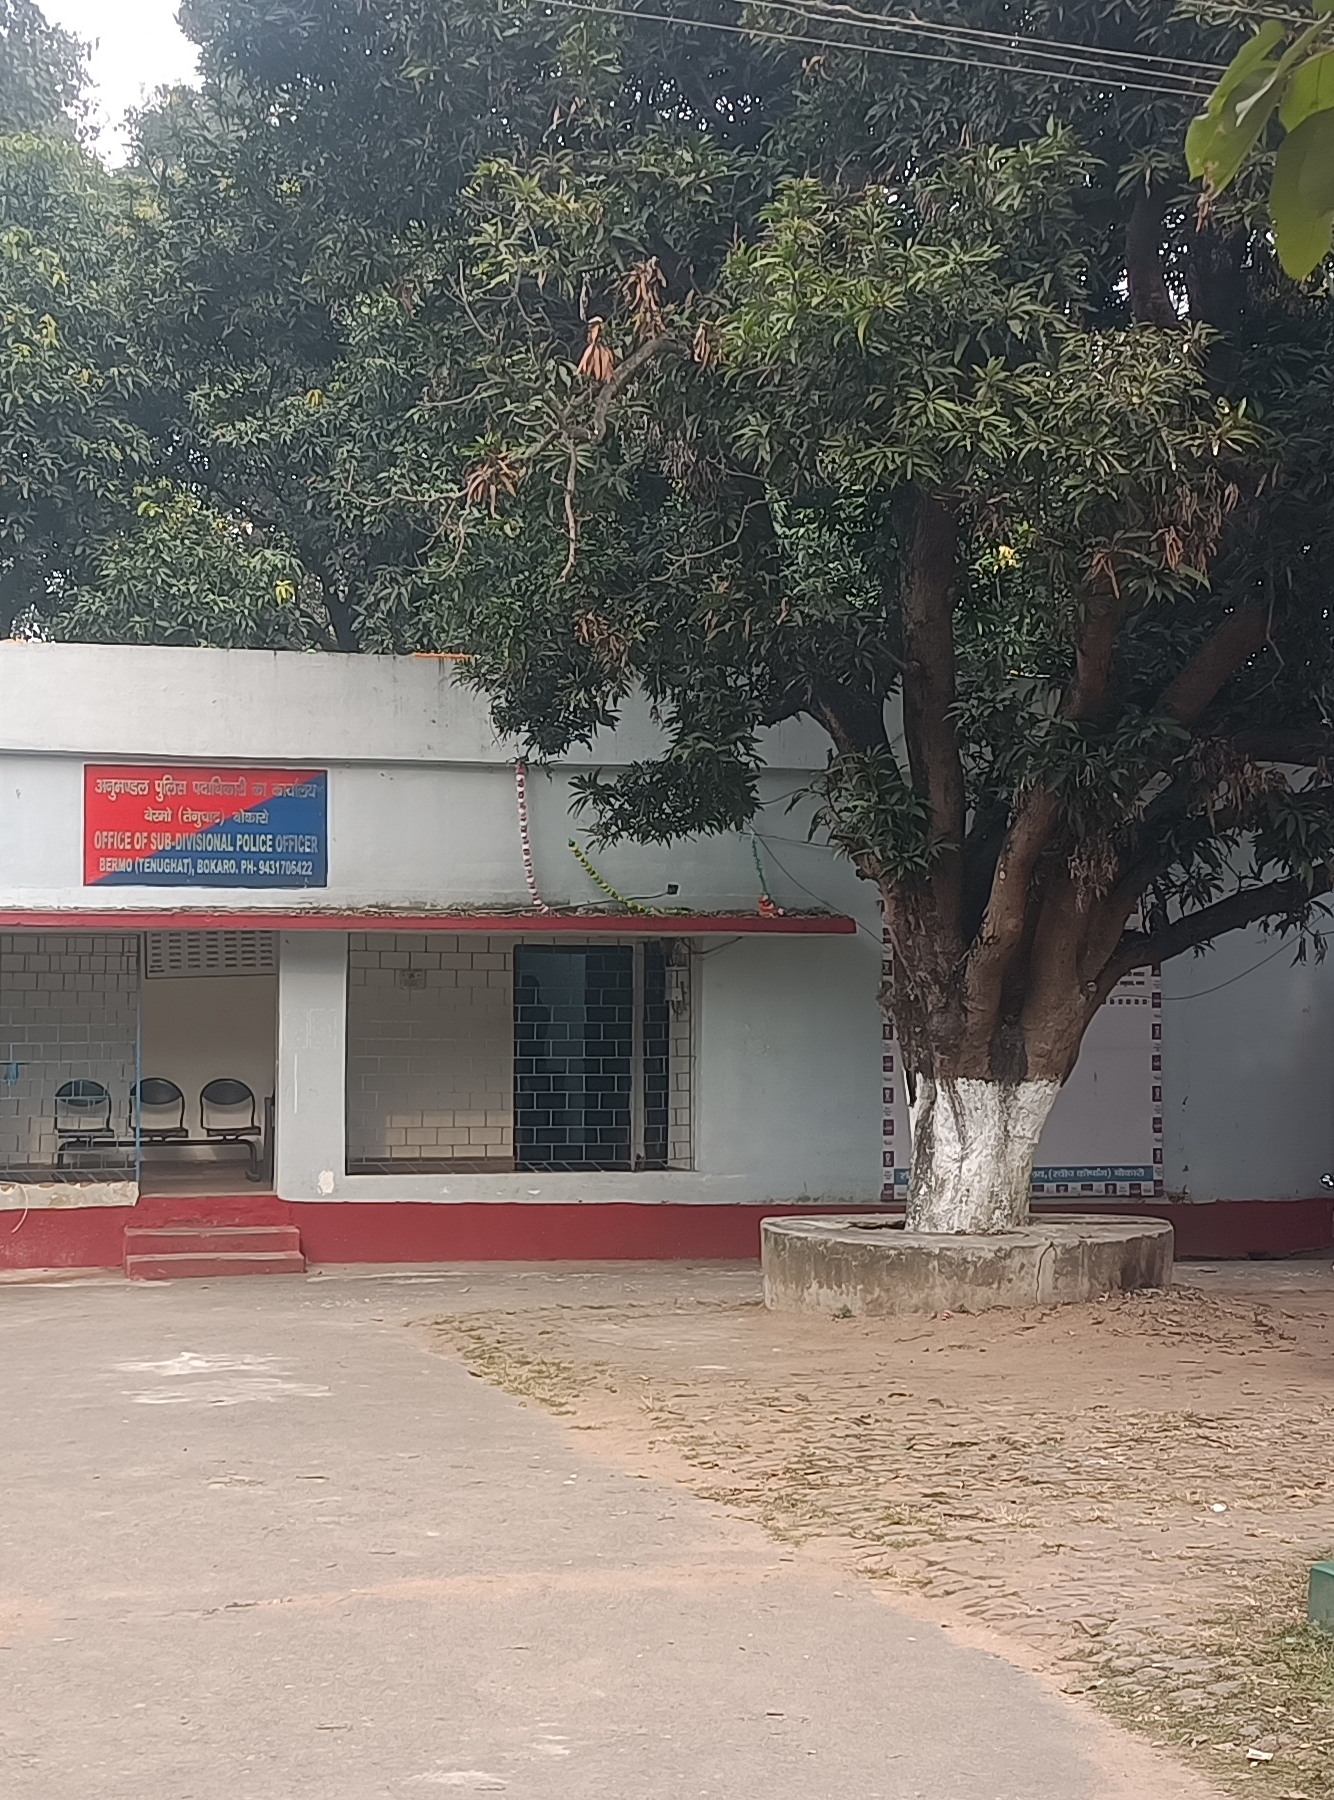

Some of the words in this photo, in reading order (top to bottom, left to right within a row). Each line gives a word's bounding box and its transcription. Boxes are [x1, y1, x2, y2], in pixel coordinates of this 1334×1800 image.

[155, 774, 187, 802] पुलिस
[252, 783, 267, 796] का
[94, 831, 131, 850] OFFICE
[134, 832, 148, 850] OF
[150, 832, 234, 852] SUB-DIVISIONAL
[236, 834, 272, 852] POLICE
[275, 834, 318, 853] OFFICER
[99, 857, 132, 872] BERMO
[135, 857, 194, 876] (TENUGHAT),
[197, 859, 238, 874] BOKARO.
